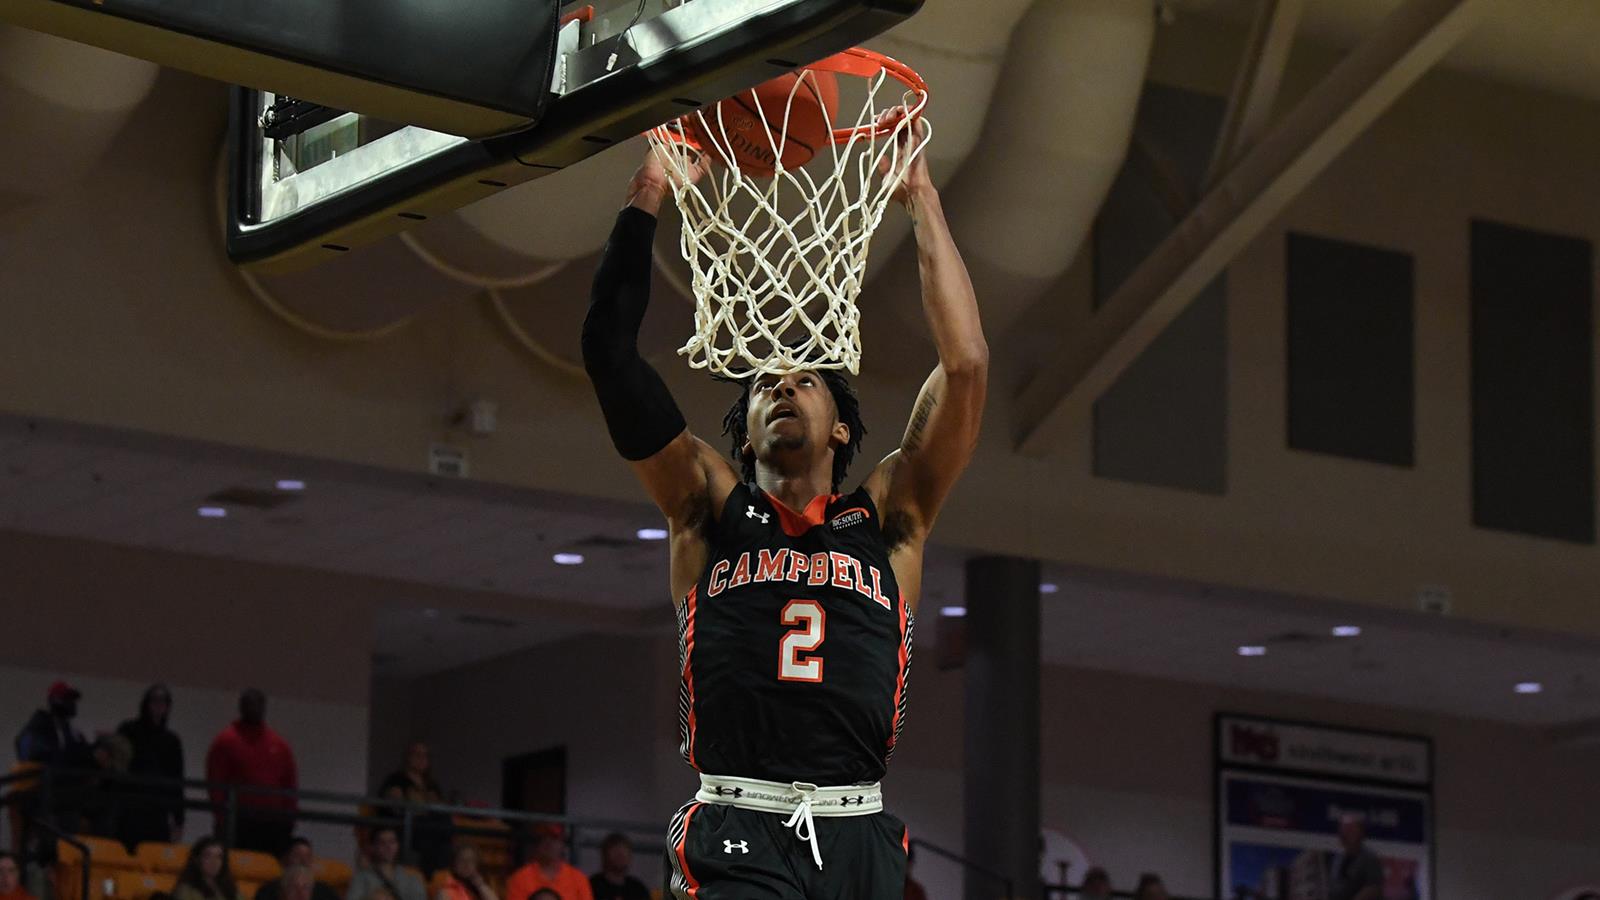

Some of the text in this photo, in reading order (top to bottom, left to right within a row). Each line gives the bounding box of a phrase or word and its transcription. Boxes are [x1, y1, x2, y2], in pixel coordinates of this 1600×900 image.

[842, 511, 862, 524] SOUTH
[707, 548, 892, 610] CAMPBELL
[777, 599, 826, 683] 2
